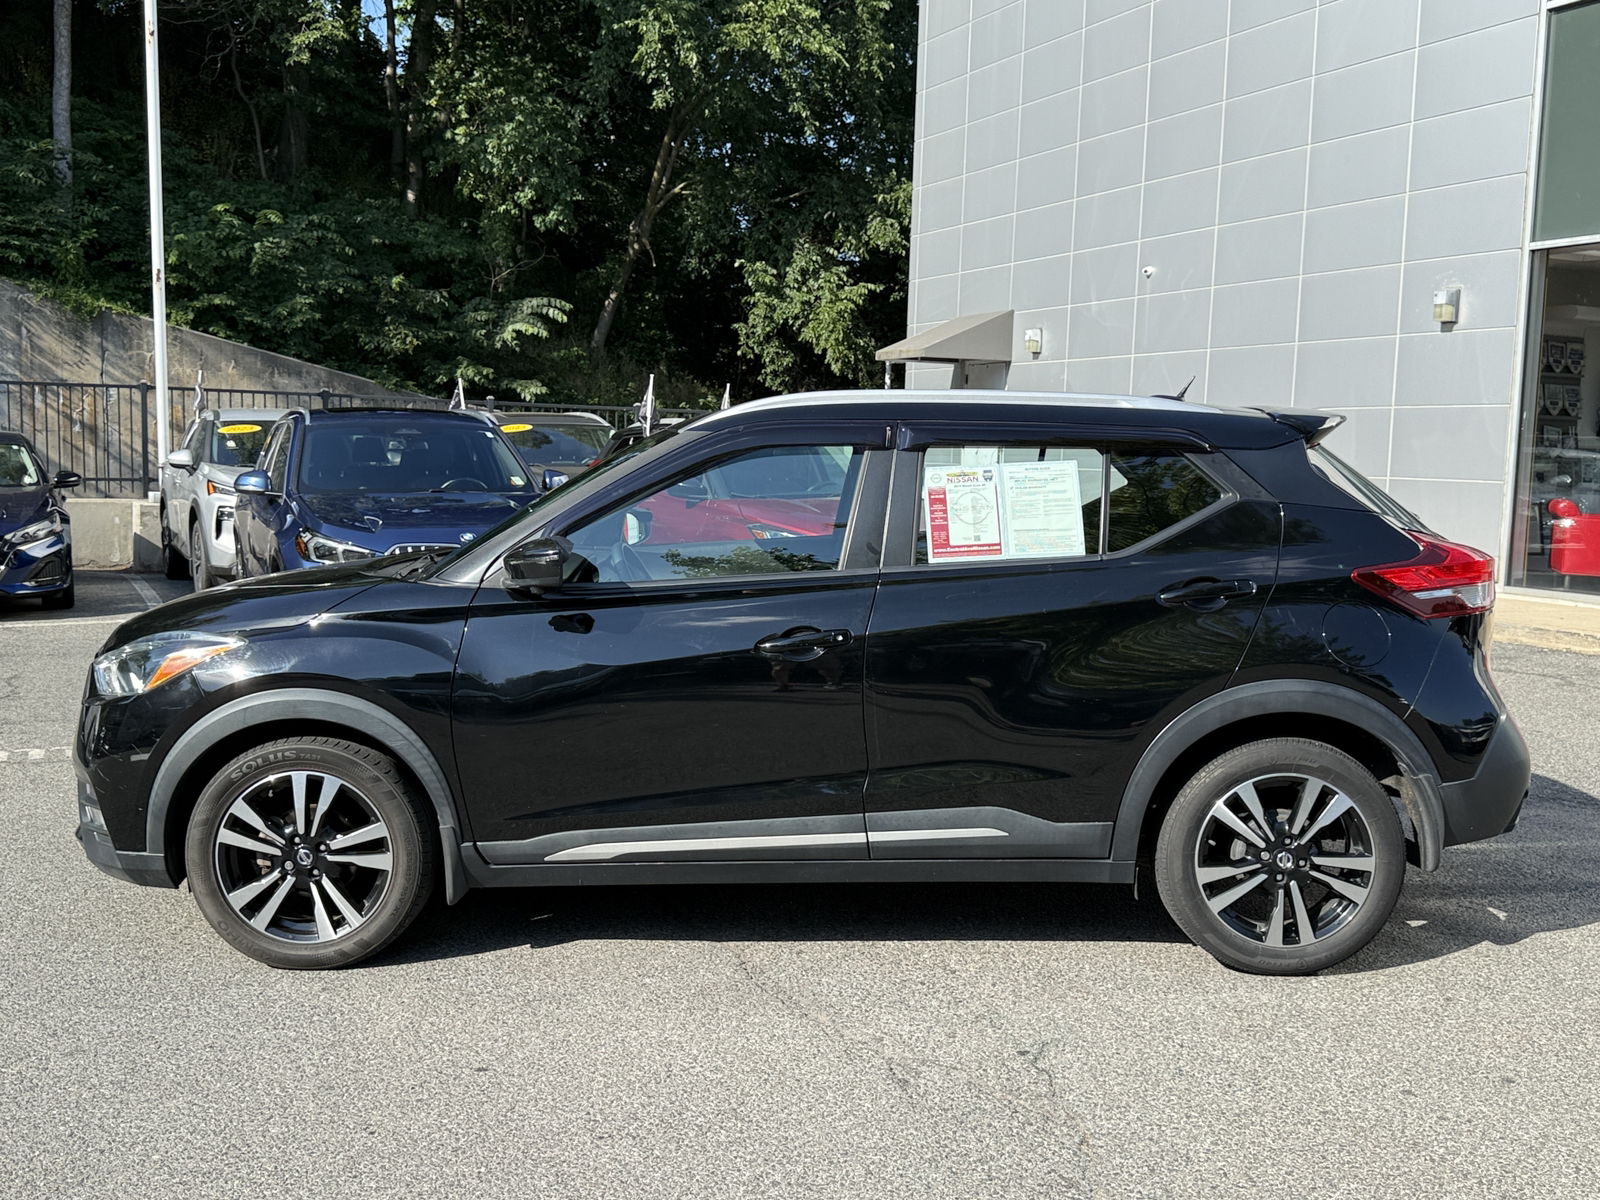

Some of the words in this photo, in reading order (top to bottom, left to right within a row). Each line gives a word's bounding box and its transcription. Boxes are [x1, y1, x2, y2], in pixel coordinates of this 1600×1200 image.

[947, 476, 979, 484] NISSAN
[230, 750, 297, 782] SOLUS
[300, 753, 321, 761] TA31
[389, 905, 401, 918] XL
[217, 920, 277, 961] KUMHO
